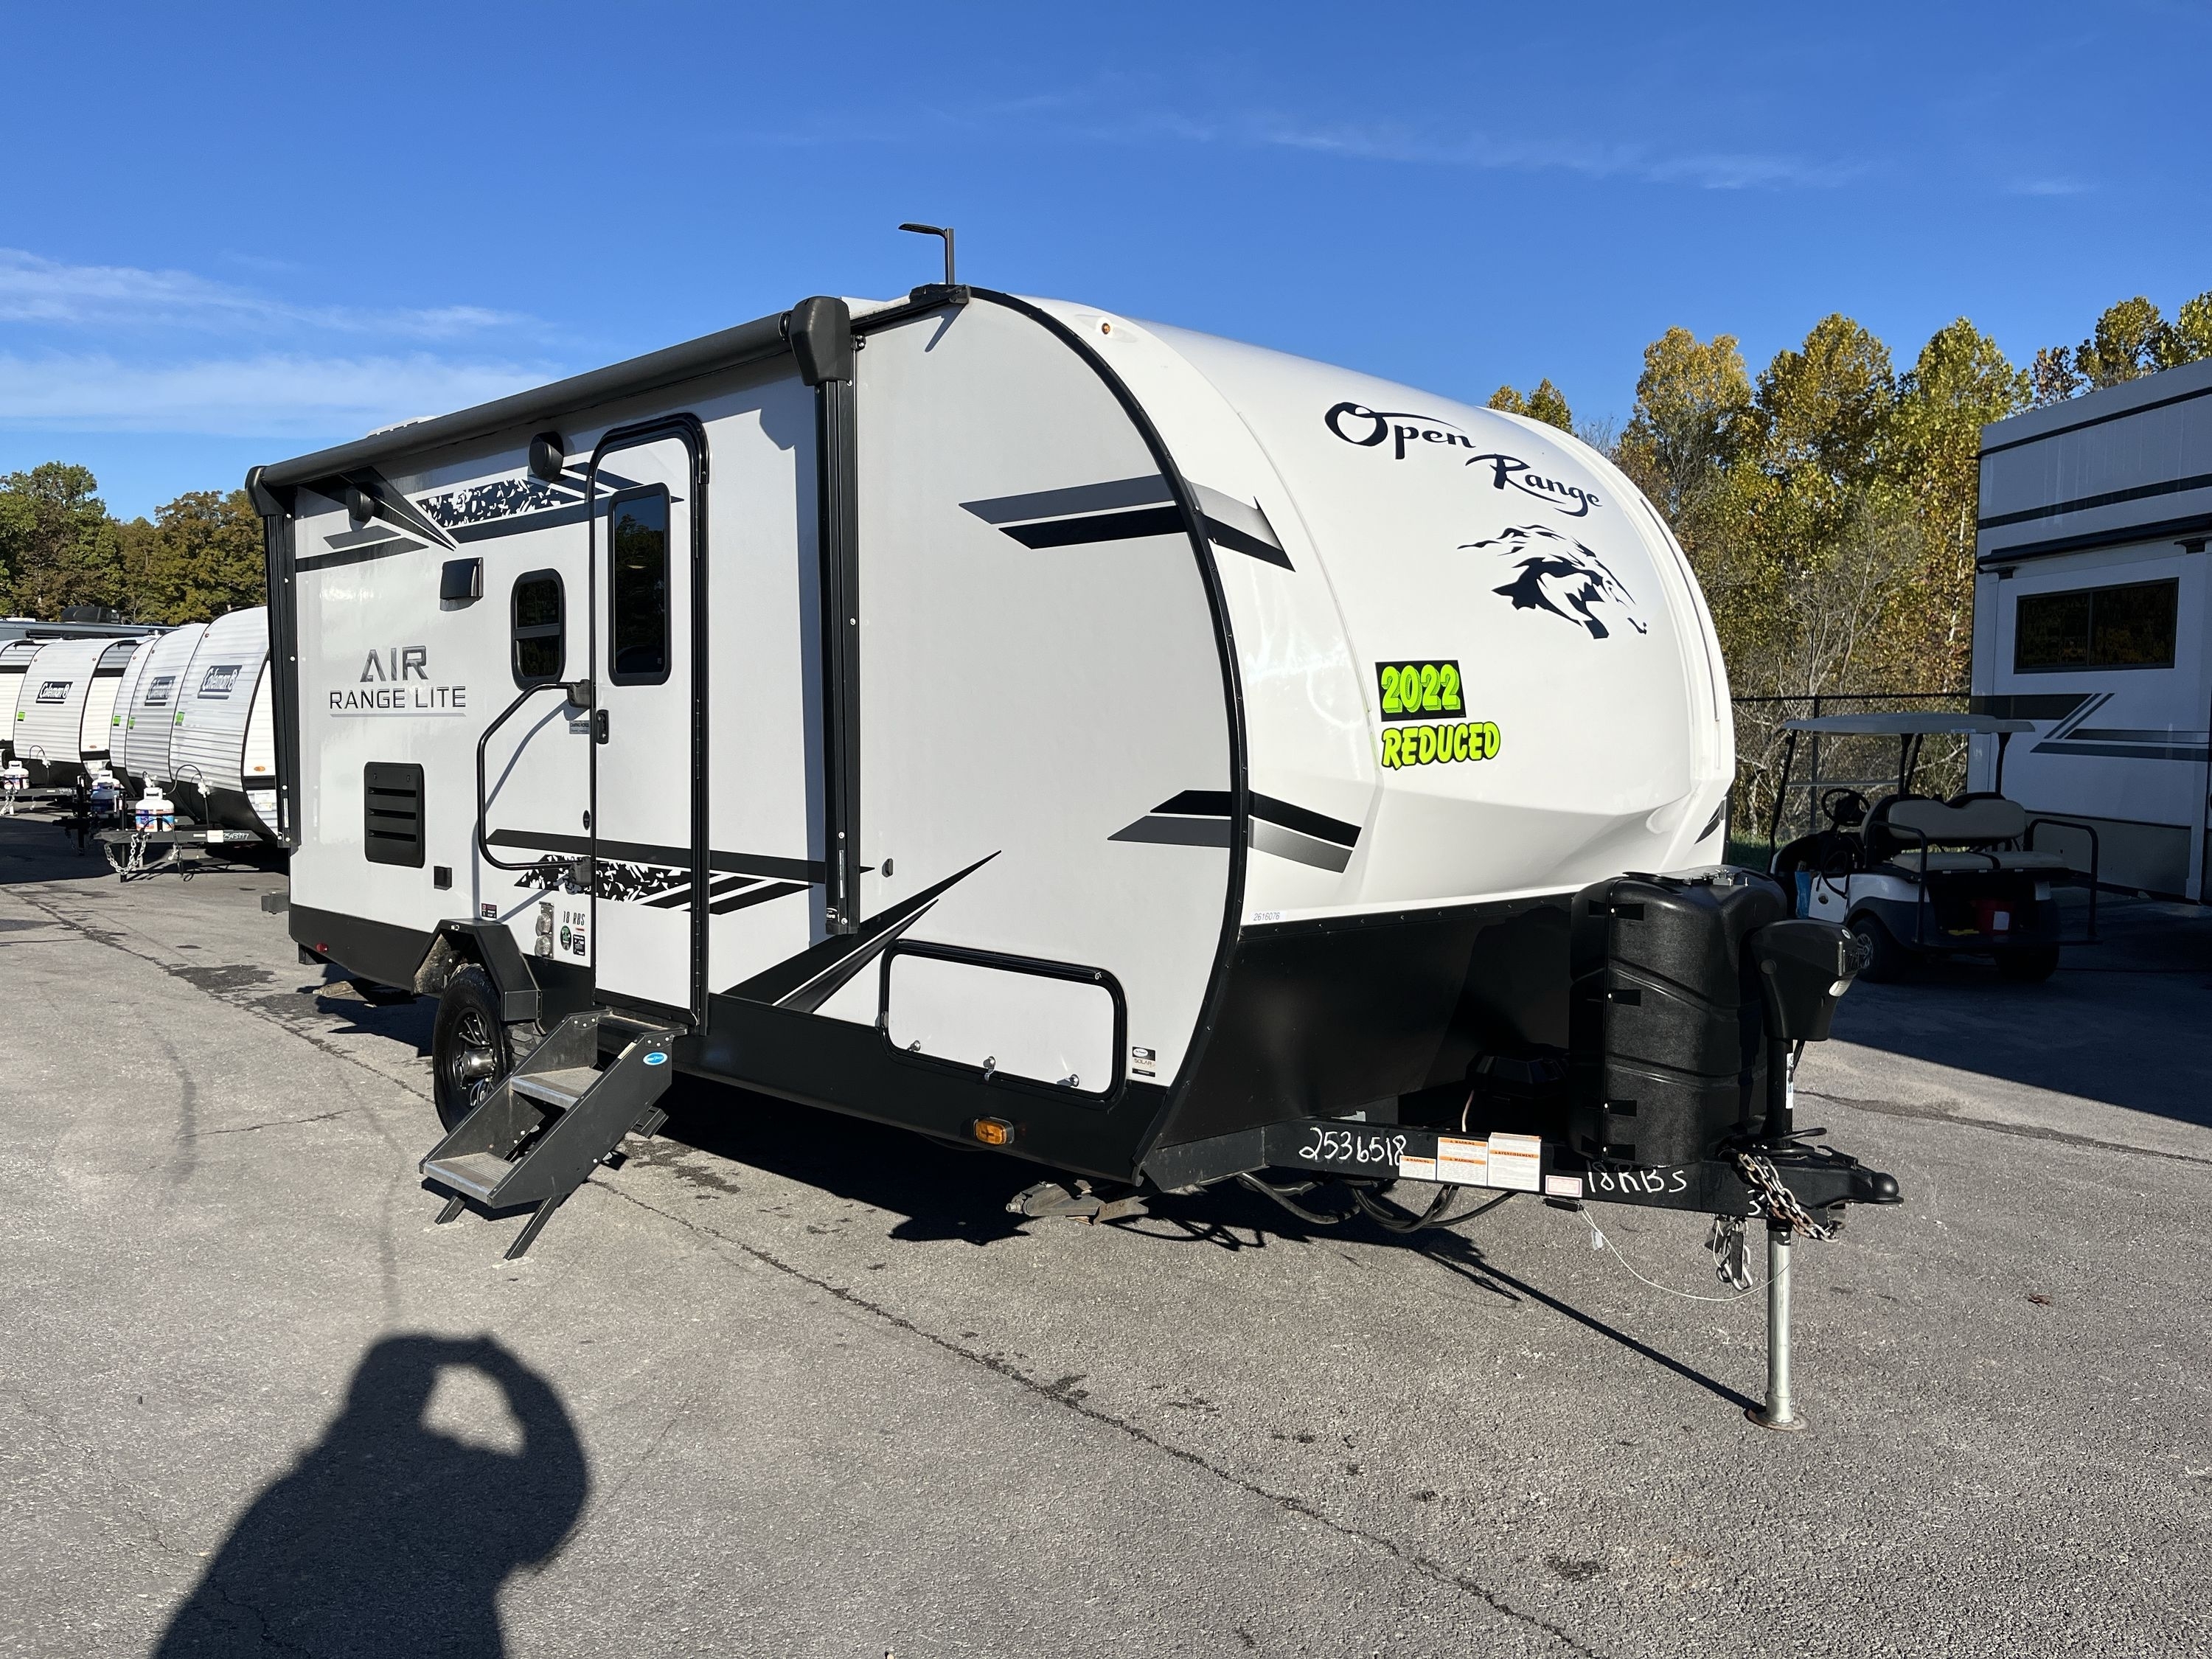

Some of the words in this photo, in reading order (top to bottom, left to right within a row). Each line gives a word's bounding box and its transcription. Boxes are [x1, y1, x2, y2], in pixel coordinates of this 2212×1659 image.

[1324, 401, 1476, 460] Open
[1465, 453, 1603, 518] Range
[360, 645, 429, 682] AIR
[330, 688, 406, 709] RANGE
[415, 686, 466, 708] LITE
[1380, 664, 1462, 714] 2022
[1381, 720, 1501, 771] REDUCED
[563, 911, 570, 923] 18
[1253, 911, 1280, 921] 2616076
[1298, 1127, 1407, 1166] 2536518
